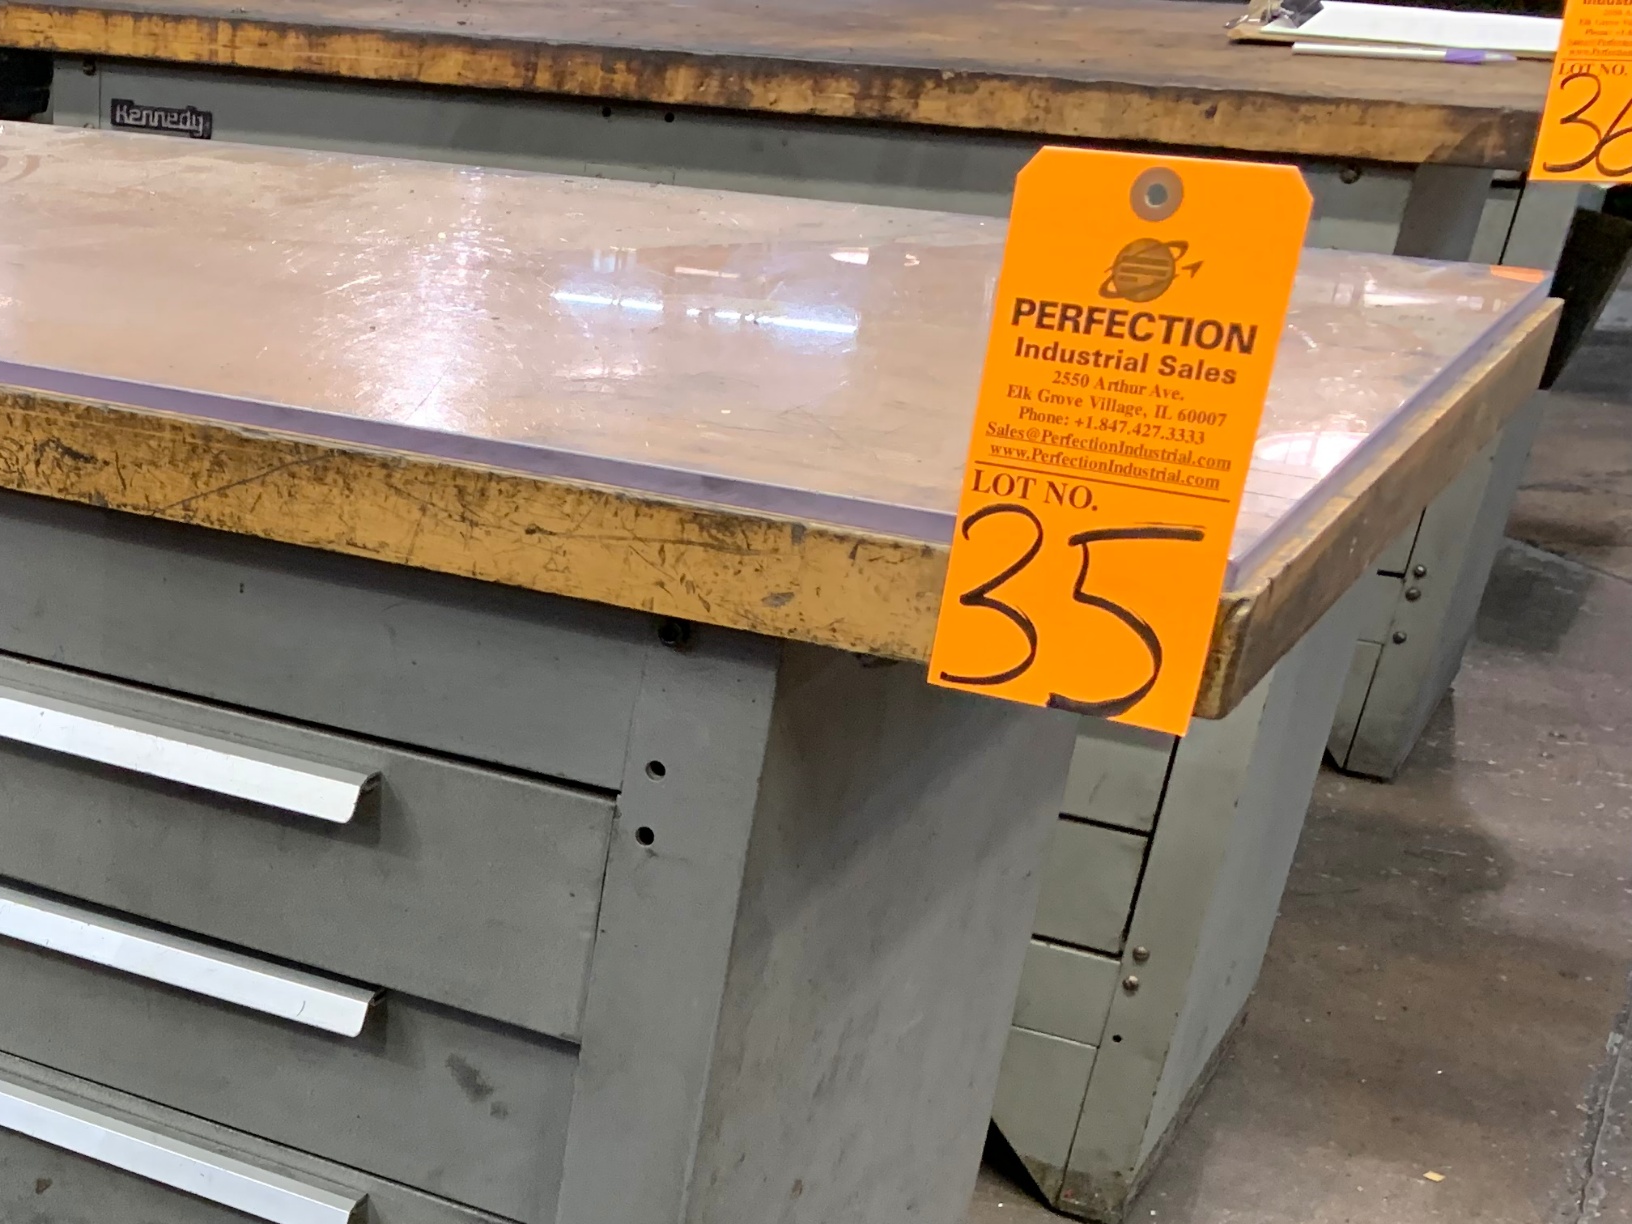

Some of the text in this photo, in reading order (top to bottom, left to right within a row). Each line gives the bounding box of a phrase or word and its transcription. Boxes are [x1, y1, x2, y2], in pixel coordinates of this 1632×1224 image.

[1599, 63, 1628, 76] NO.
[115, 104, 204, 137] Kennedy
[1011, 297, 1258, 355] PERFECTION
[1014, 336, 1237, 385] Industrial Sales
[1007, 384, 1228, 427] Elk Grove Village, IL 60007
[1052, 370, 1184, 401] 2550 Arthur Ave.
[986, 421, 1232, 472] Sales@PerfectionIndustrial.com
[1019, 405, 1206, 445] Phone: +1.847.427.3333
[989, 444, 1221, 490] www.PerfectionIndustrial.com
[971, 469, 1098, 511] LOT NO.
[940, 502, 1207, 718] 35
